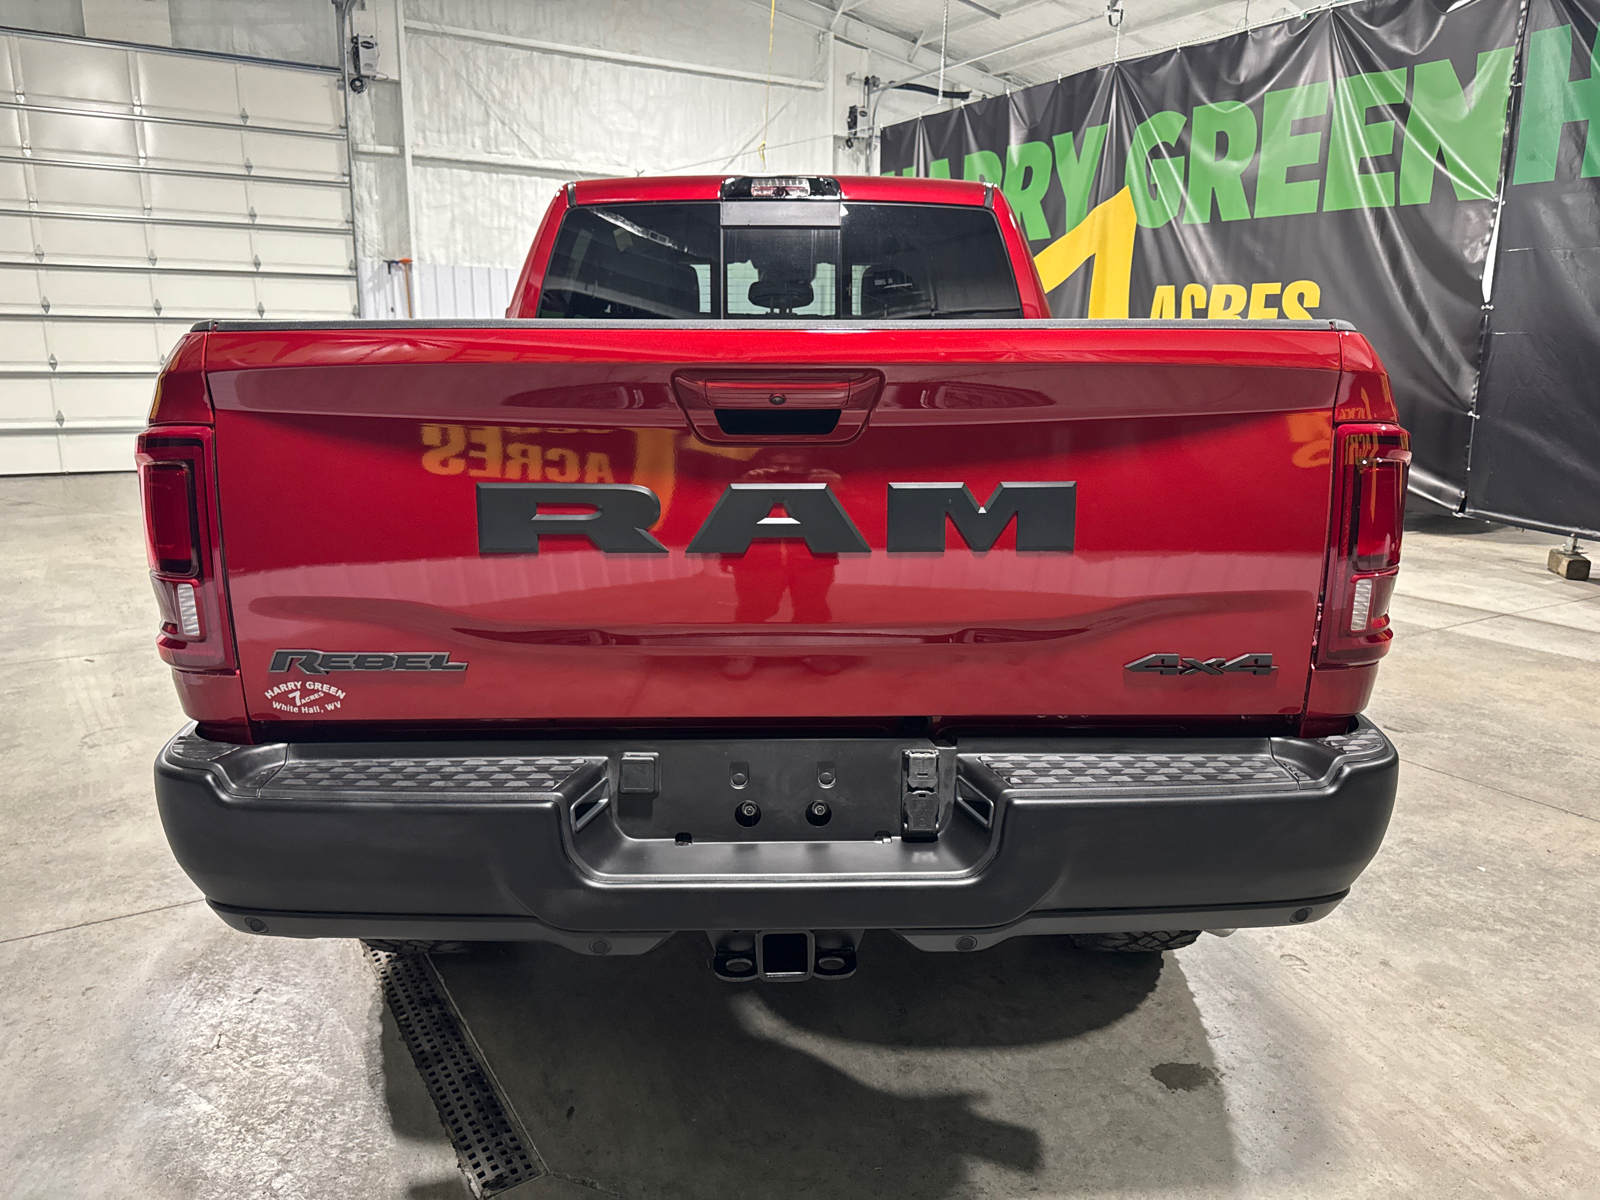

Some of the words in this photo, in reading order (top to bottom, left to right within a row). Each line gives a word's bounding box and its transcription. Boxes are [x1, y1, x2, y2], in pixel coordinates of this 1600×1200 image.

[1124, 46, 1516, 229] GREEN
[476, 480, 1077, 554] RAM
[268, 648, 469, 676] REBEL
[264, 681, 303, 700] HARRY
[305, 681, 347, 700] GREEN
[287, 690, 302, 707] 7
[301, 691, 325, 705] ACRES
[272, 700, 299, 714] White
[301, 705, 325, 714] Hall,
[324, 700, 342, 711] WV
